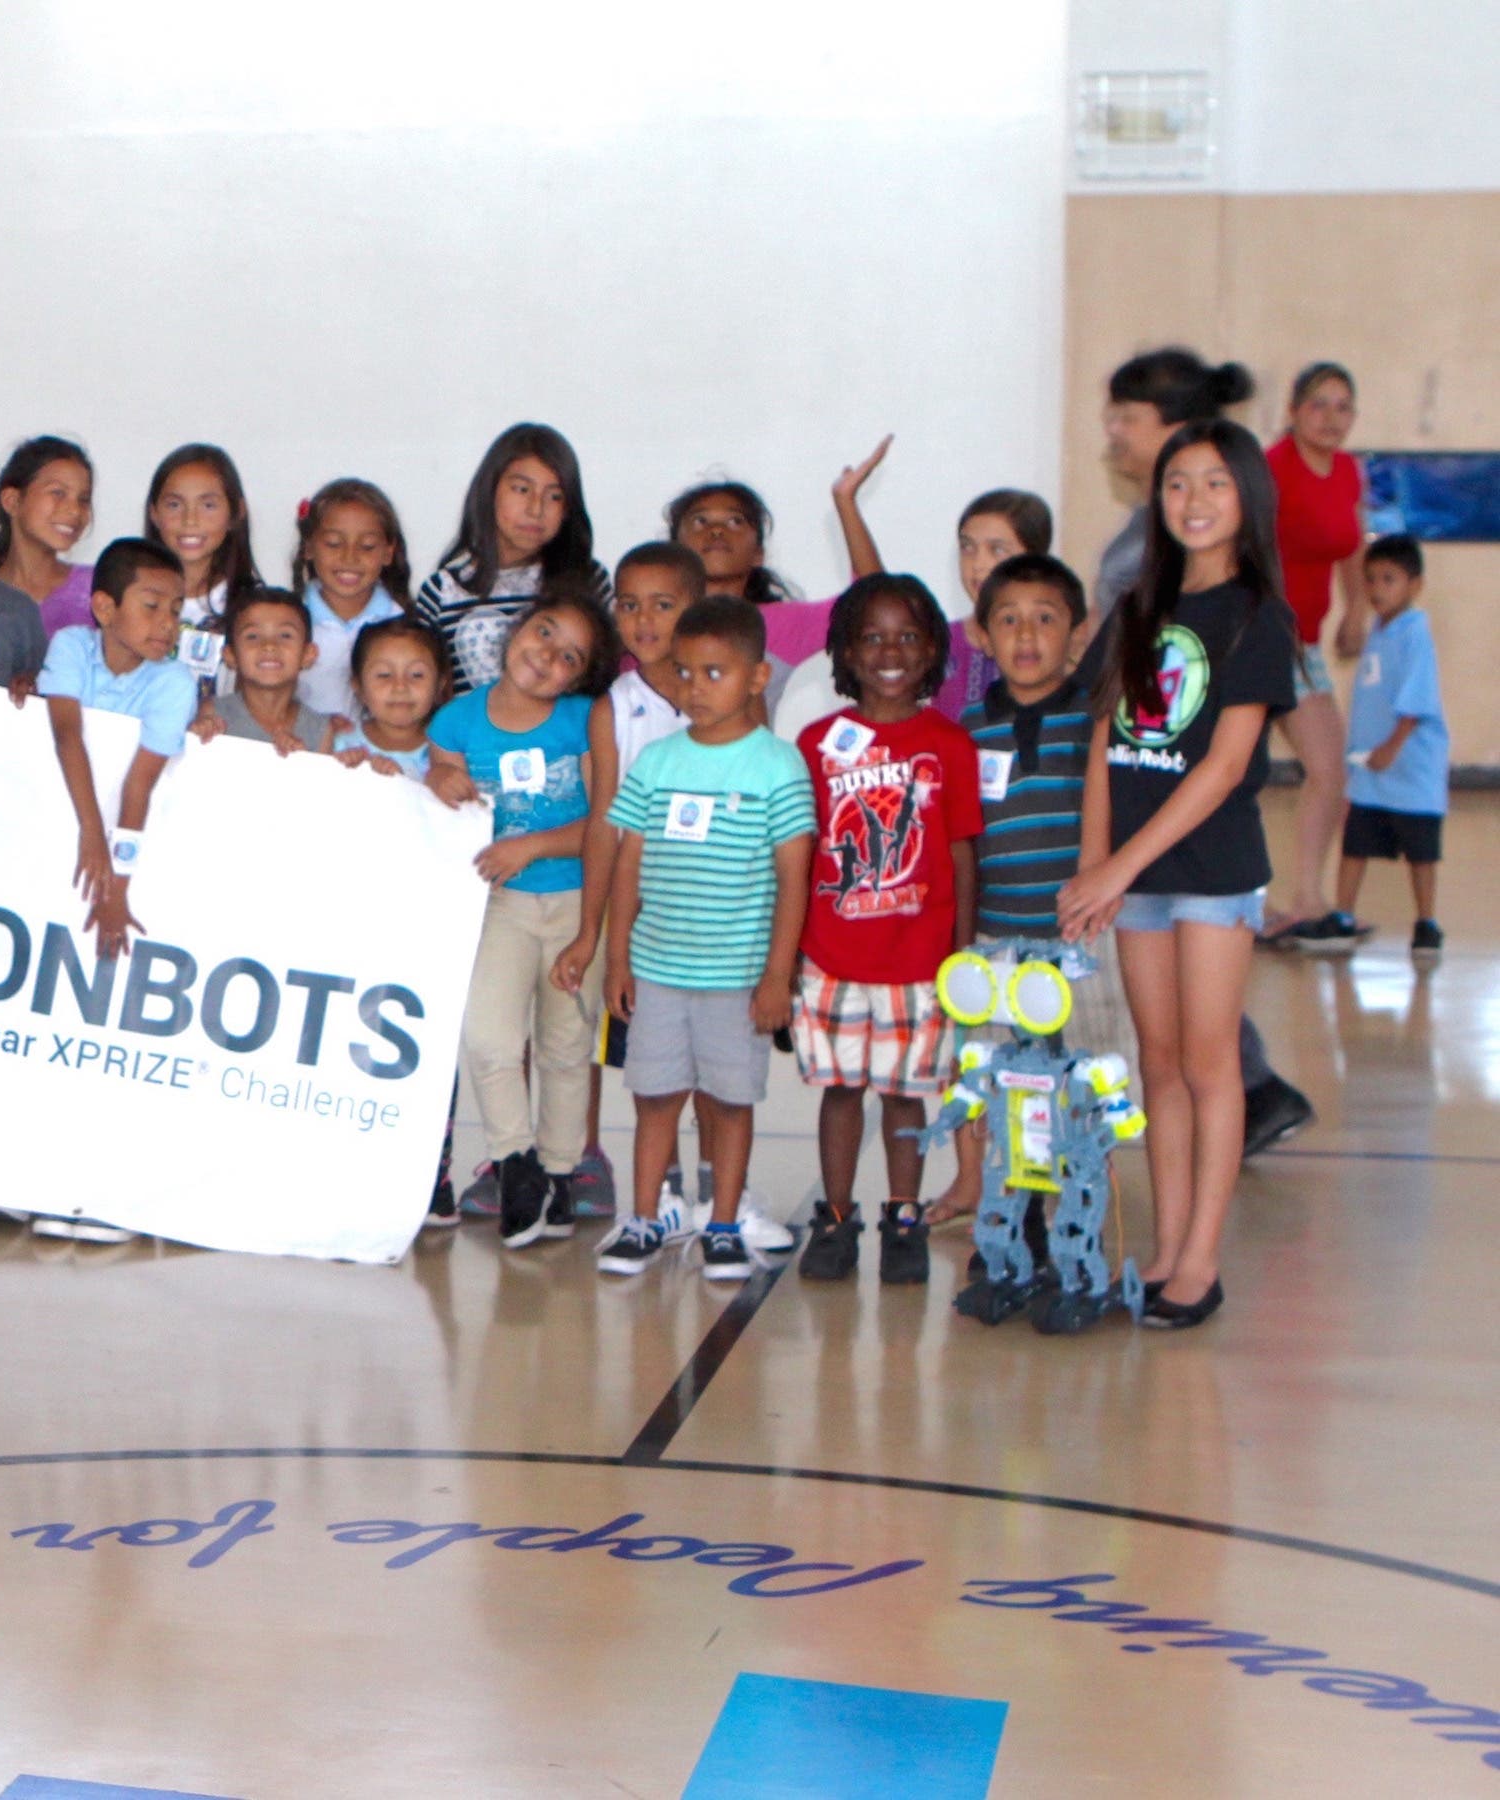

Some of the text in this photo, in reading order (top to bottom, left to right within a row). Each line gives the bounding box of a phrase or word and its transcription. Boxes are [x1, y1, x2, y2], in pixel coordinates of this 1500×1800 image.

[828, 762, 911, 798] DUNK!
[221, 1067, 400, 1132] Challenge
[10, 1500, 277, 1568] for
[326, 1512, 925, 1598] People
